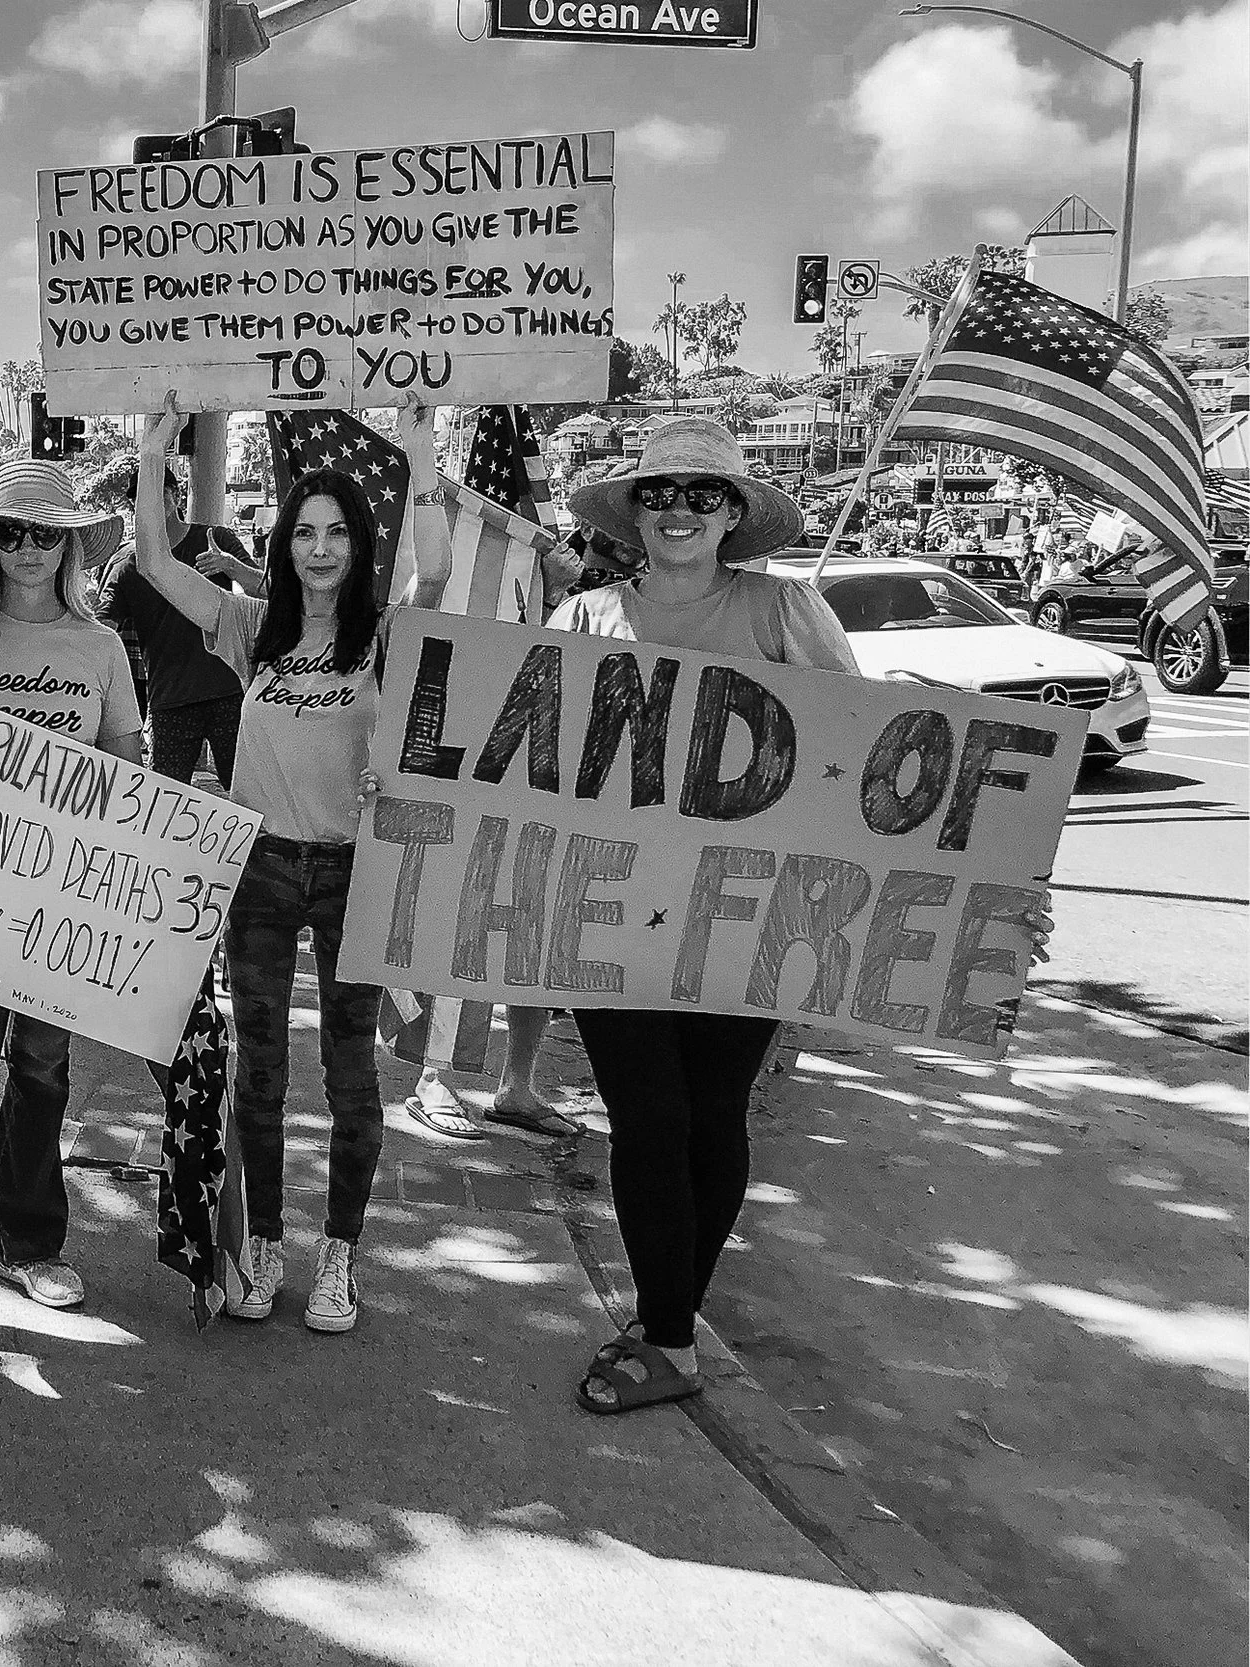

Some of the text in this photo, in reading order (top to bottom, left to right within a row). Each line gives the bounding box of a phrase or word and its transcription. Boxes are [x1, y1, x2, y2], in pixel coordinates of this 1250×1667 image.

[529, 0, 720, 33] Ocean Ave
[54, 133, 613, 217] FREEDOM IS ESSENTIAL
[49, 203, 580, 265] IN PROPORTION AS YOU GIVE THE
[47, 276, 135, 305] STATE
[144, 271, 232, 301] POWER
[284, 268, 327, 295] DO
[331, 267, 438, 297] THINGS
[444, 265, 512, 298] FOR
[523, 261, 592, 299] YOU,
[48, 307, 613, 348] YOU GIVE THEM POWER to DO THINGS
[256, 347, 452, 390] TO YOU
[926, 466, 987, 476] LGUNA
[255, 675, 355, 718] keeper
[397, 636, 1058, 851] LAND OF
[116, 772, 254, 866] 3,175,692
[60, 838, 171, 924] DEATHS
[170, 874, 232, 941] 35
[372, 795, 1049, 1046] THE FREE
